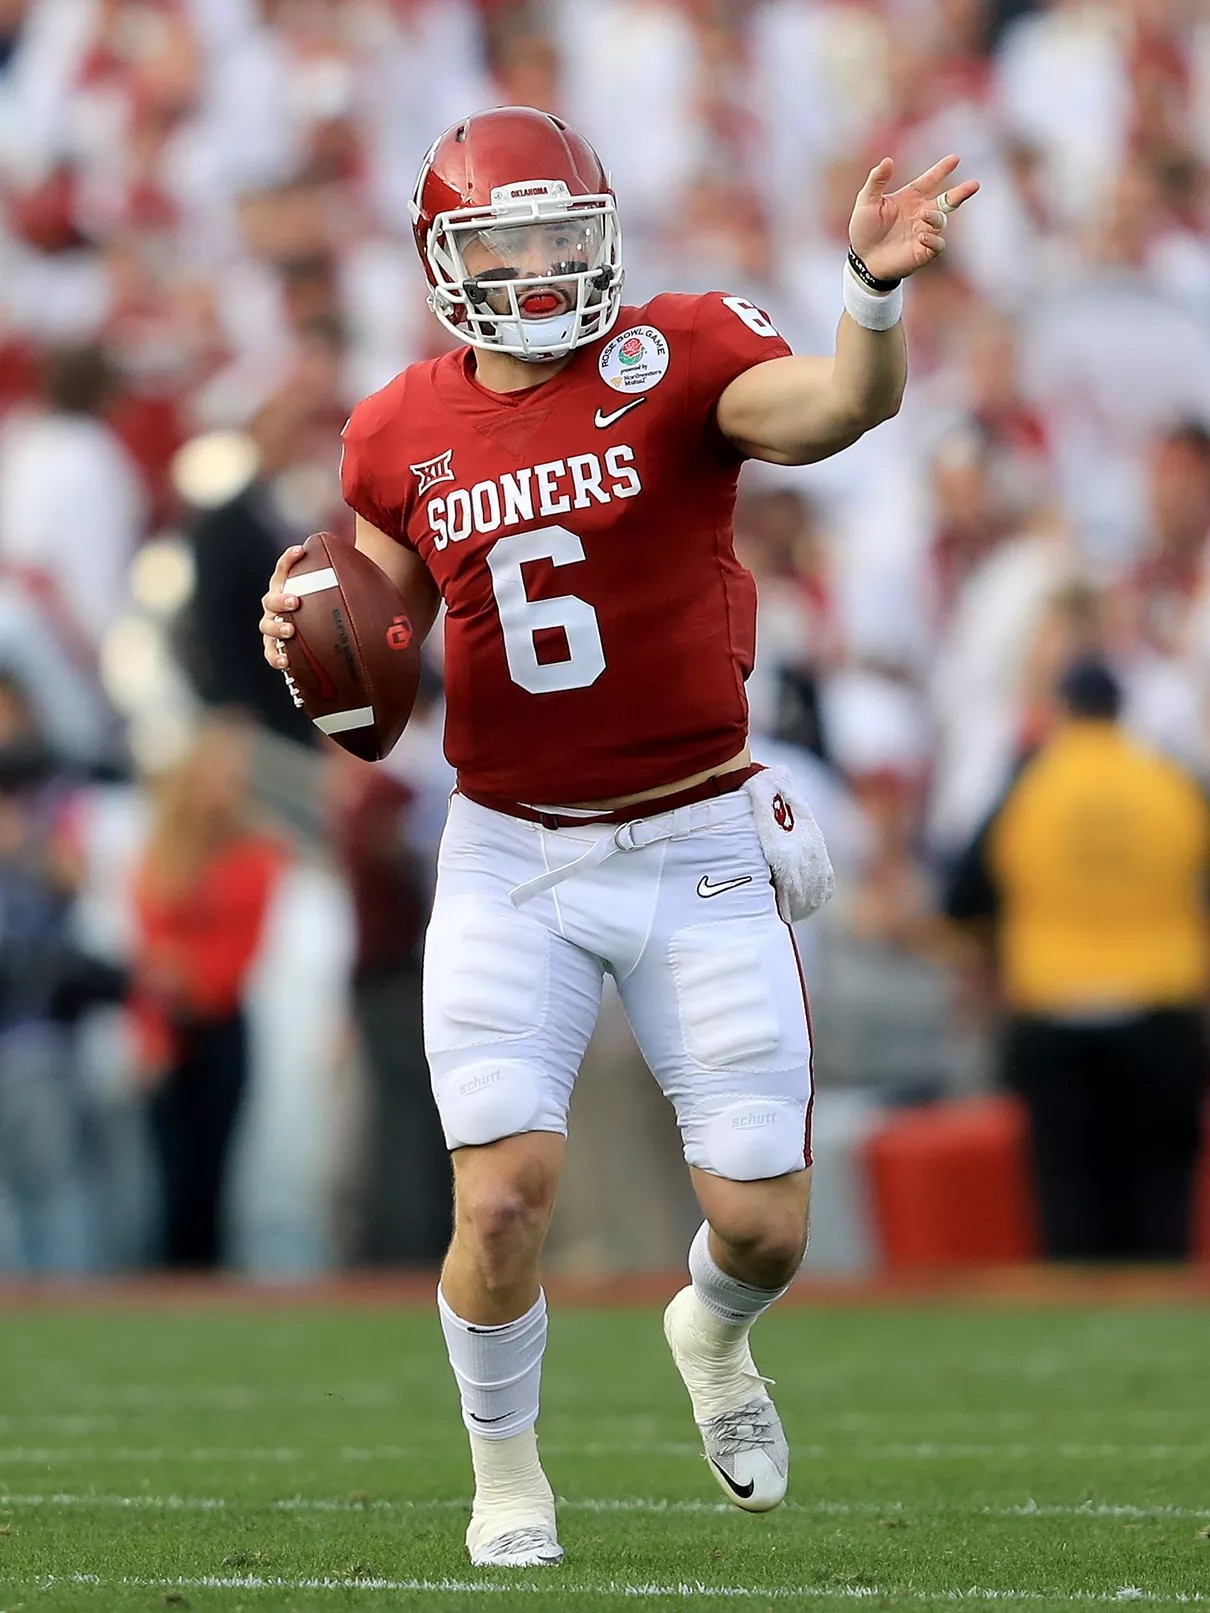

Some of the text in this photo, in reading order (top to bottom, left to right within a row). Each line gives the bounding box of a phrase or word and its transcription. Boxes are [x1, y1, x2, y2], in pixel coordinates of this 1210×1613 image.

[510, 187, 548, 198] OKLAHOMA
[720, 296, 780, 337] 6
[602, 328, 665, 367] ROSE BOWL GAME
[427, 444, 642, 551] SOONERS
[484, 524, 607, 695] 6
[460, 1070, 501, 1095] schutt
[731, 1112, 776, 1129] schutt
